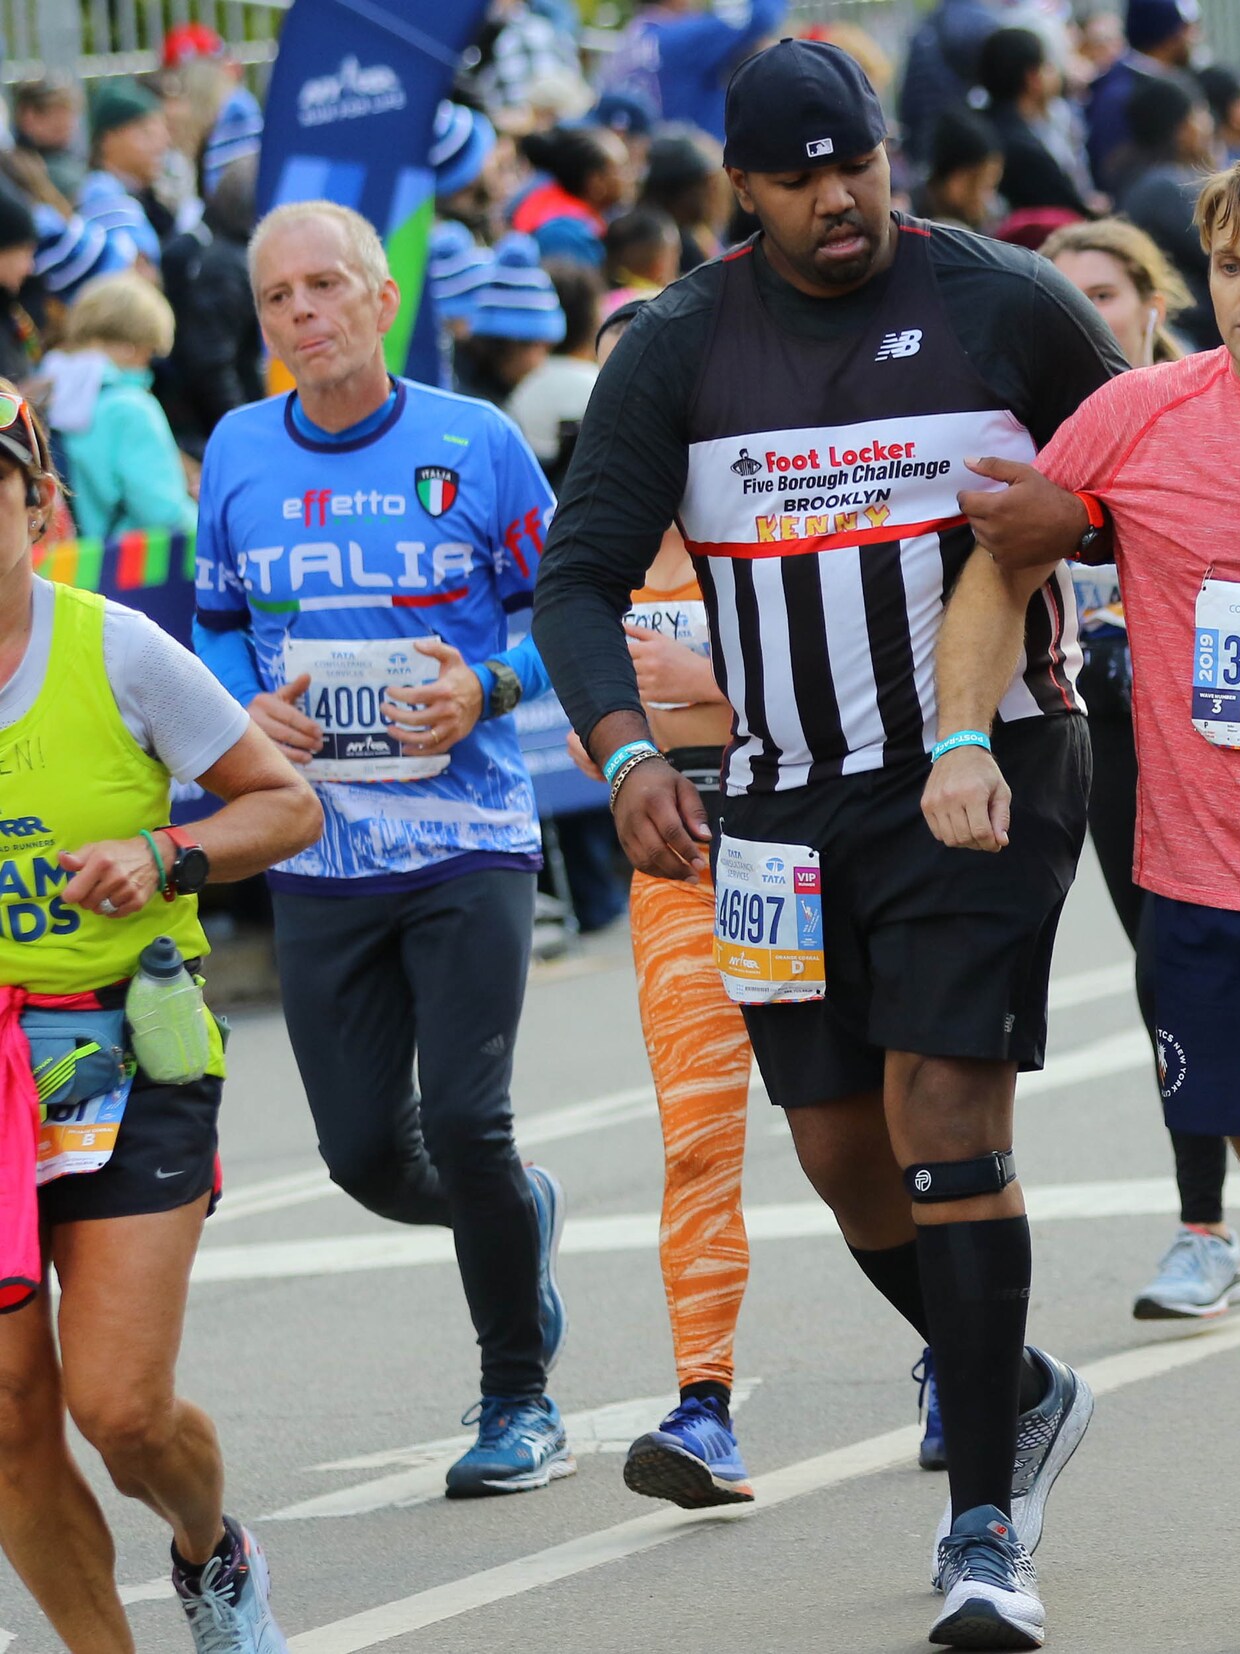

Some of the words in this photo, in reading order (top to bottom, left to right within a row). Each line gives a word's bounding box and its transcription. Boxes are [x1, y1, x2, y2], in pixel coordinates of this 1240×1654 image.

[765, 450, 821, 473] Foot
[829, 440, 915, 468] Locker
[420, 467, 452, 481] ITALIA
[743, 478, 774, 495] Five
[778, 470, 849, 492] Borough
[852, 459, 951, 484] Challenge
[783, 488, 891, 513] BROOKLYN
[282, 489, 406, 528] effetto
[755, 504, 891, 543] KENNY
[1199, 634, 1214, 682] 2019
[387, 667, 412, 675] TATA
[1211, 699, 1222, 714] 3
[13, 839, 55, 851] RUNNERS
[727, 849, 742, 859] TATA
[761, 874, 786, 884] TATA
[797, 873, 816, 882] VIP
[719, 888, 785, 945] 46197
[791, 960, 804, 974] D
[1158, 1029, 1174, 1043] TCS
[1173, 1042, 1187, 1065] NEW
[1171, 1067, 1187, 1093] YORK
[81, 1133, 96, 1146] B
